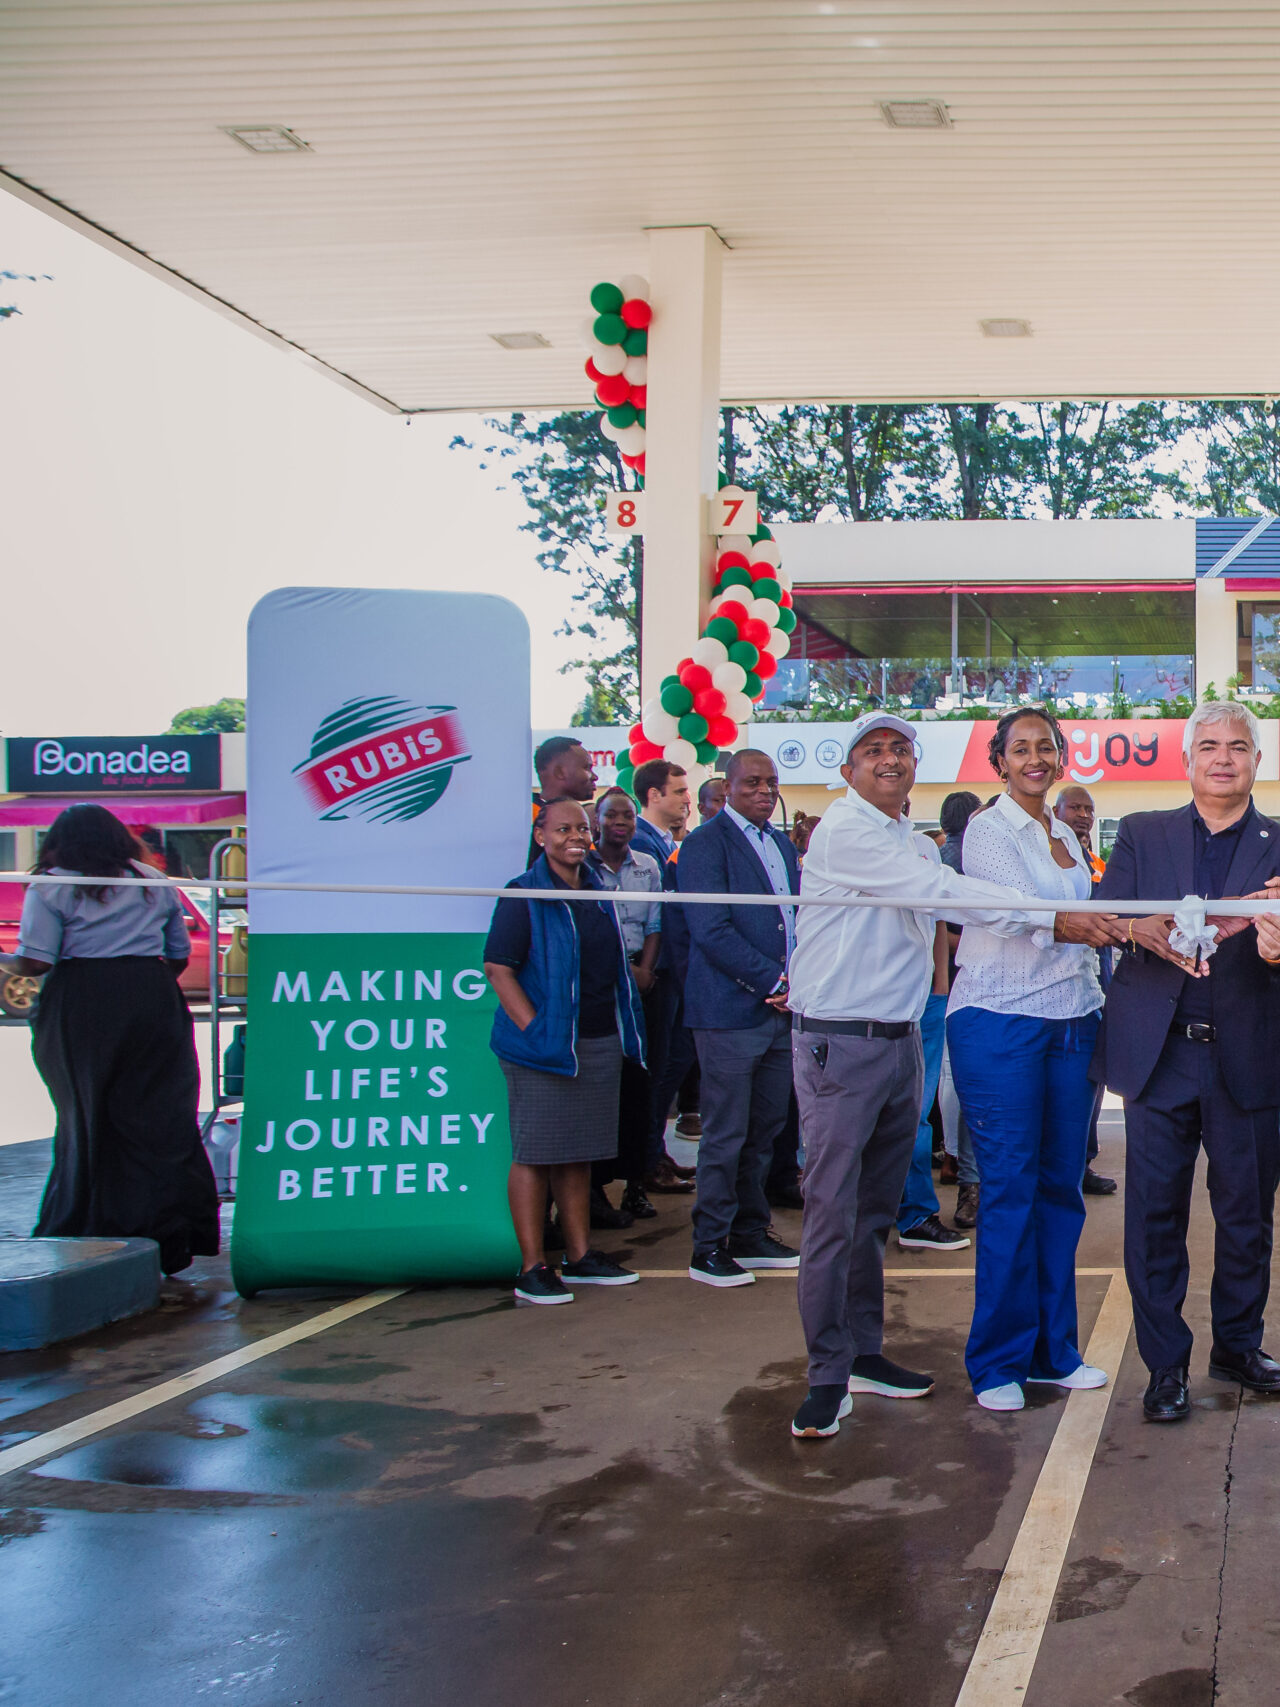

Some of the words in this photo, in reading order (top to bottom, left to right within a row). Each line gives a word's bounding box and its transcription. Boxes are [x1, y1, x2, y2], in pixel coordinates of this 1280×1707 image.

[616, 500, 637, 528] 8
[722, 500, 744, 526] 7
[33, 740, 191, 776] Bonadea
[272, 968, 487, 1002] MAKING
[310, 1018, 448, 1051] YOUR
[305, 1066, 449, 1101] LIFE'S
[255, 1113, 495, 1153] JOURNEY
[278, 1162, 468, 1200] BETTER.
